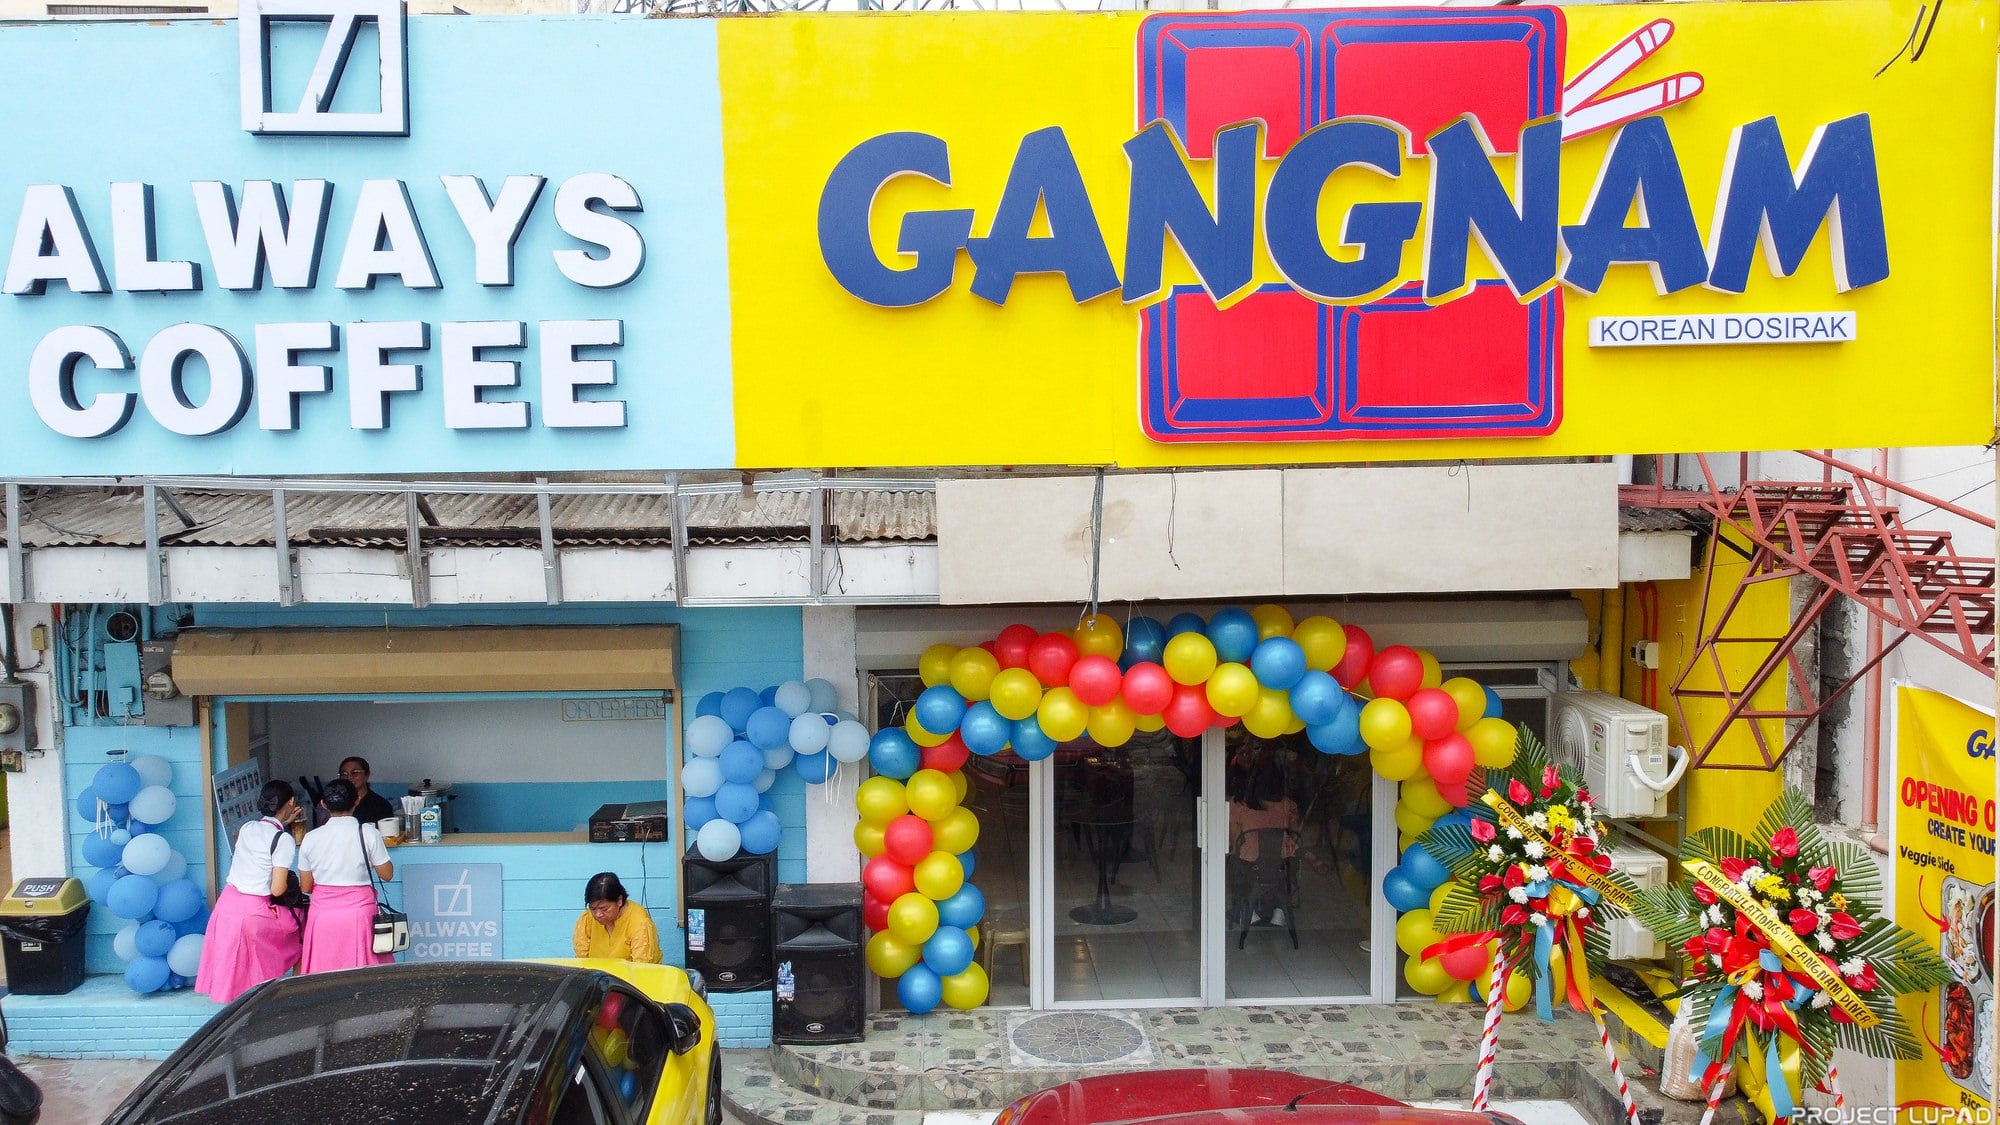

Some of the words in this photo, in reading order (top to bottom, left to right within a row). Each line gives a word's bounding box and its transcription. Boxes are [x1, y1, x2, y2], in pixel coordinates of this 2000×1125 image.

[818, 113, 1890, 306] GANGNAM
[4, 171, 645, 295] ALWAYS
[1600, 318, 1716, 343] KOREAN
[1724, 315, 1849, 341] DOSIRAK
[28, 320, 628, 439] COFFEE
[565, 700, 621, 718] ORDER
[1902, 777, 1978, 827] OPENING
[1928, 818, 1967, 847] CREATE
[1900, 845, 1937, 868] Veggie
[1938, 856, 1955, 875] Side
[23, 884, 57, 892] PUSH
[410, 921, 498, 937] ALWAYS
[414, 942, 492, 957] COFFEE
[1791, 944, 1843, 995] GANGNAM
